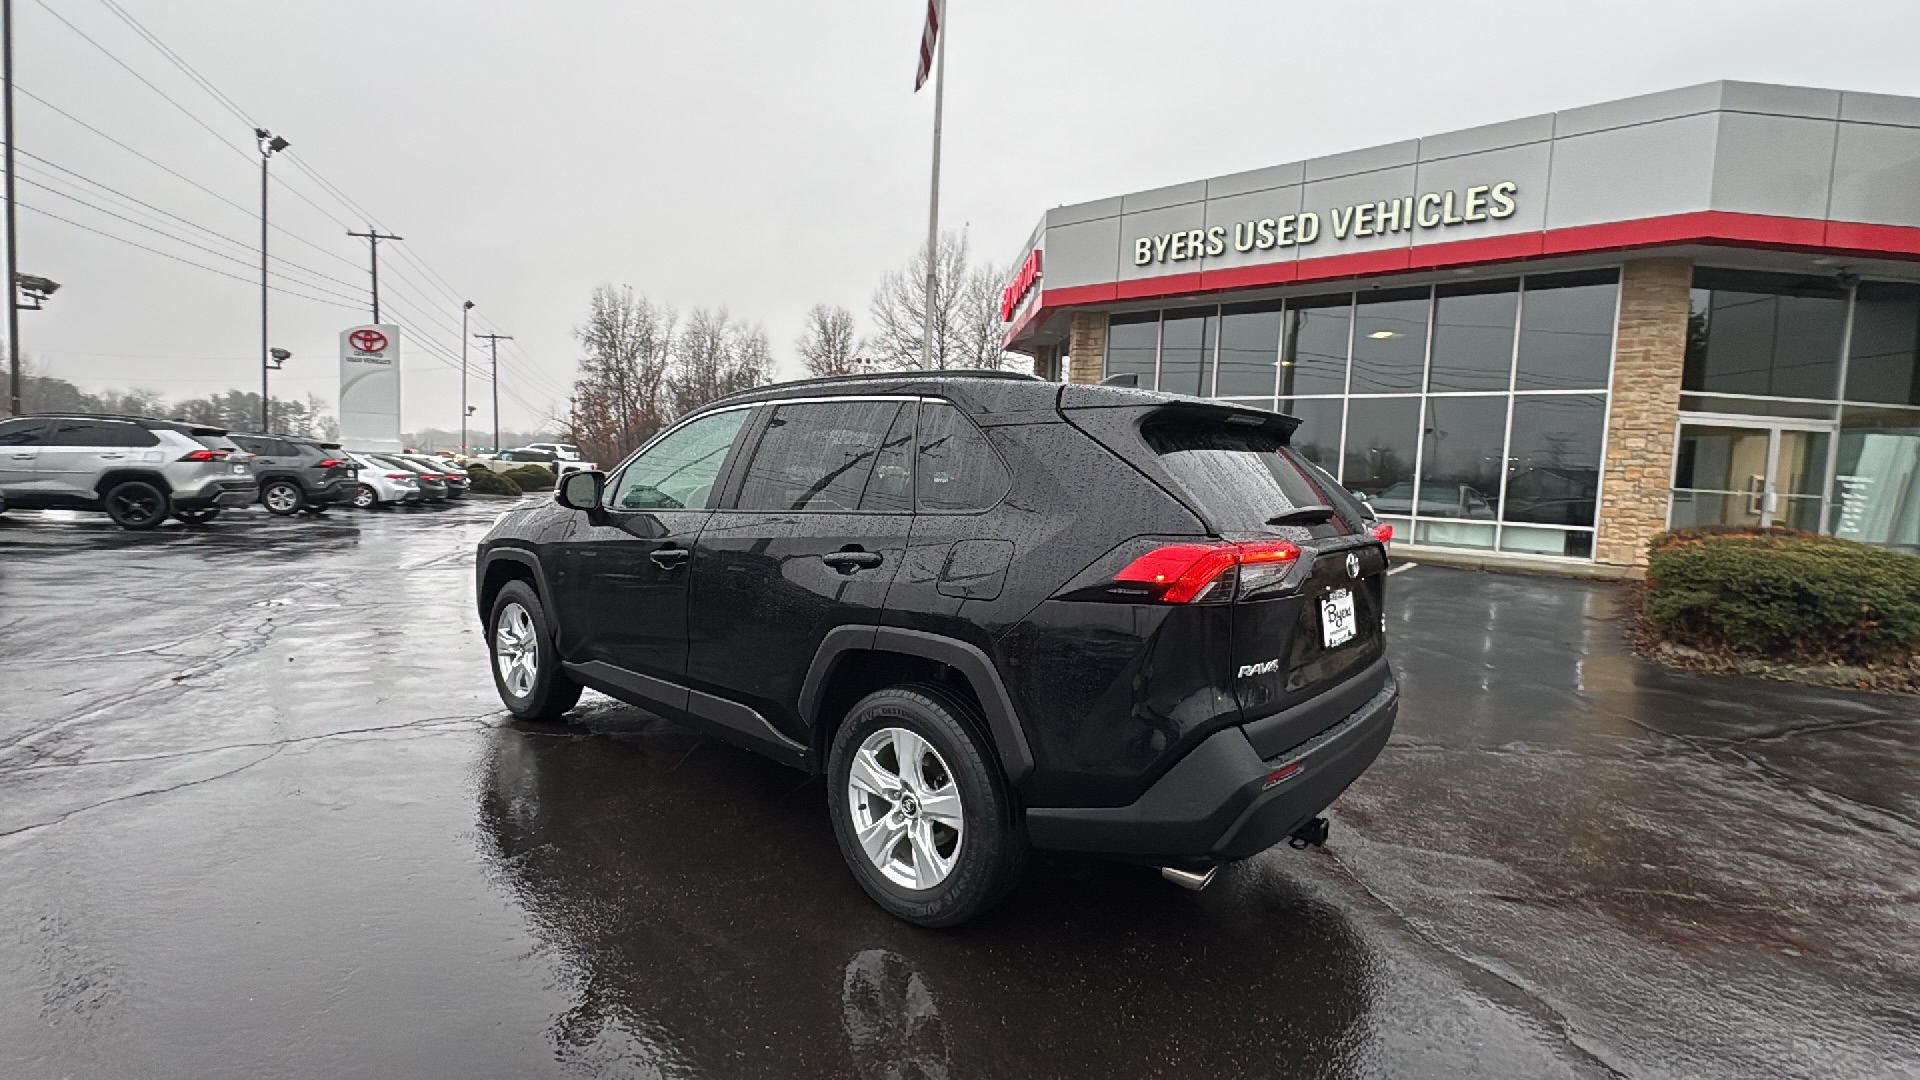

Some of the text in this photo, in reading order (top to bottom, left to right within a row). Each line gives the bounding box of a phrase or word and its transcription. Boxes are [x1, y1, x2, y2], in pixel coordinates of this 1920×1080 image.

[1135, 181, 1518, 266] BYERS USED VEHICLES
[1237, 658, 1279, 679] RAV4
